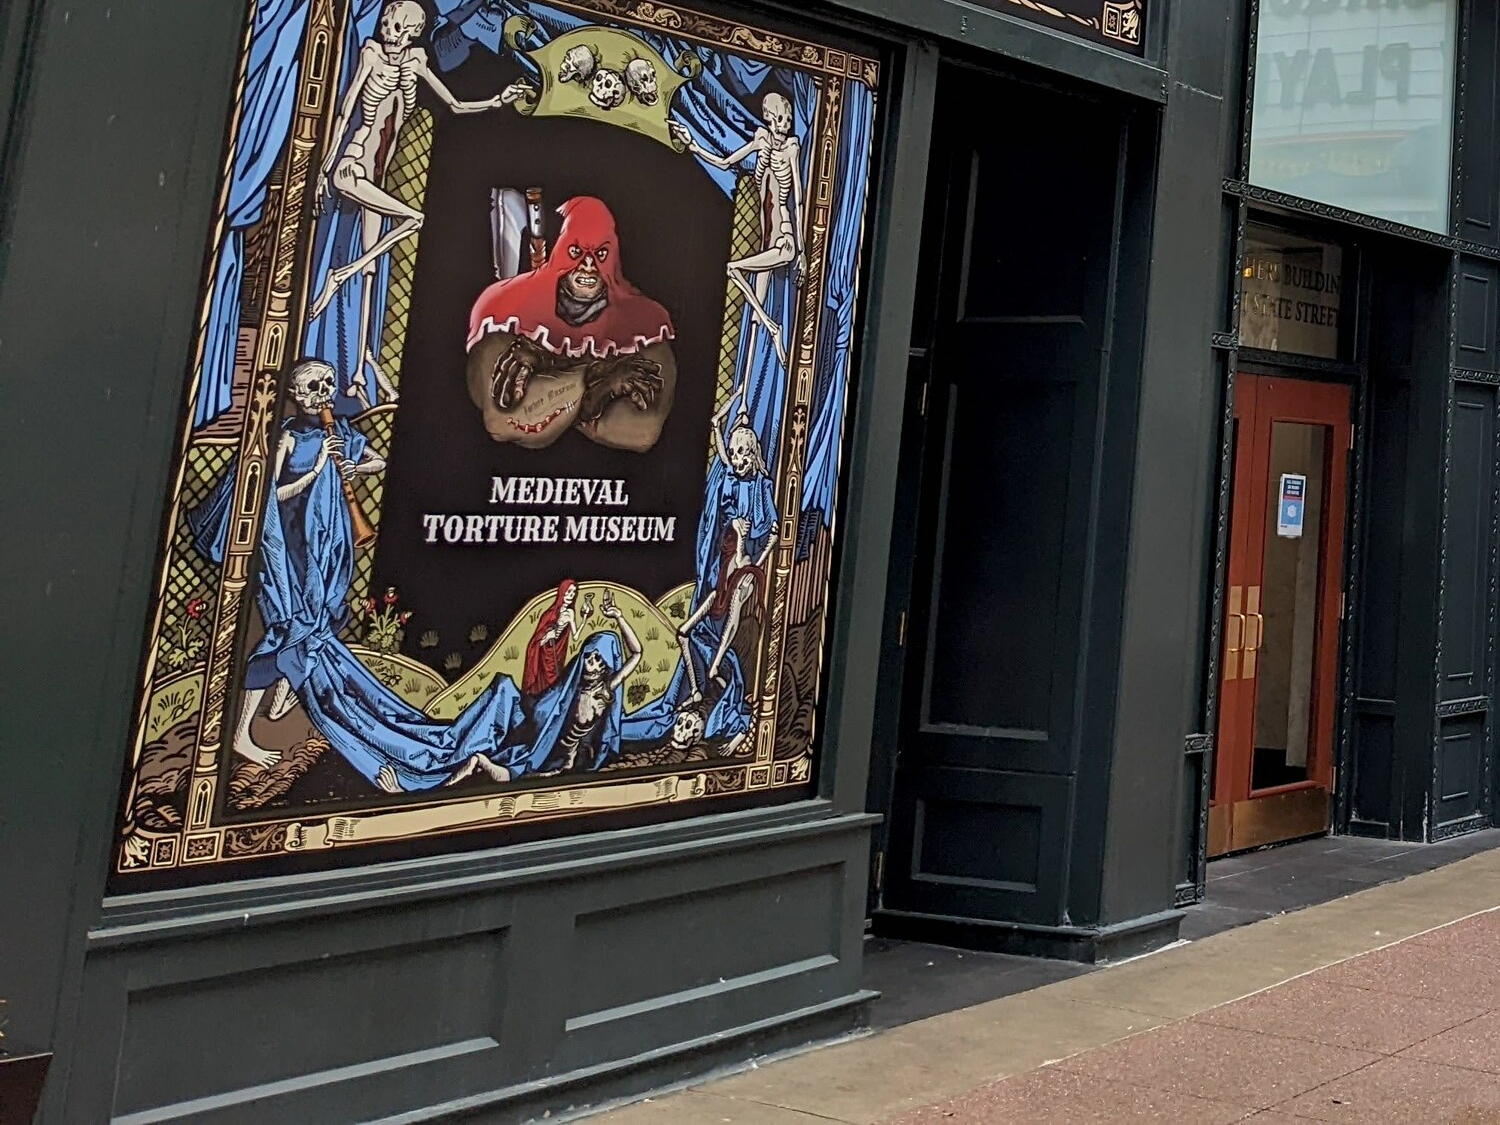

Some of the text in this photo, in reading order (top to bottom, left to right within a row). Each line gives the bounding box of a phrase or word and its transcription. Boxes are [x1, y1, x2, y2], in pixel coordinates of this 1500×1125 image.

[488, 476, 629, 505] MEDIEVAL
[423, 514, 677, 542] TORTURE MUSEUM
